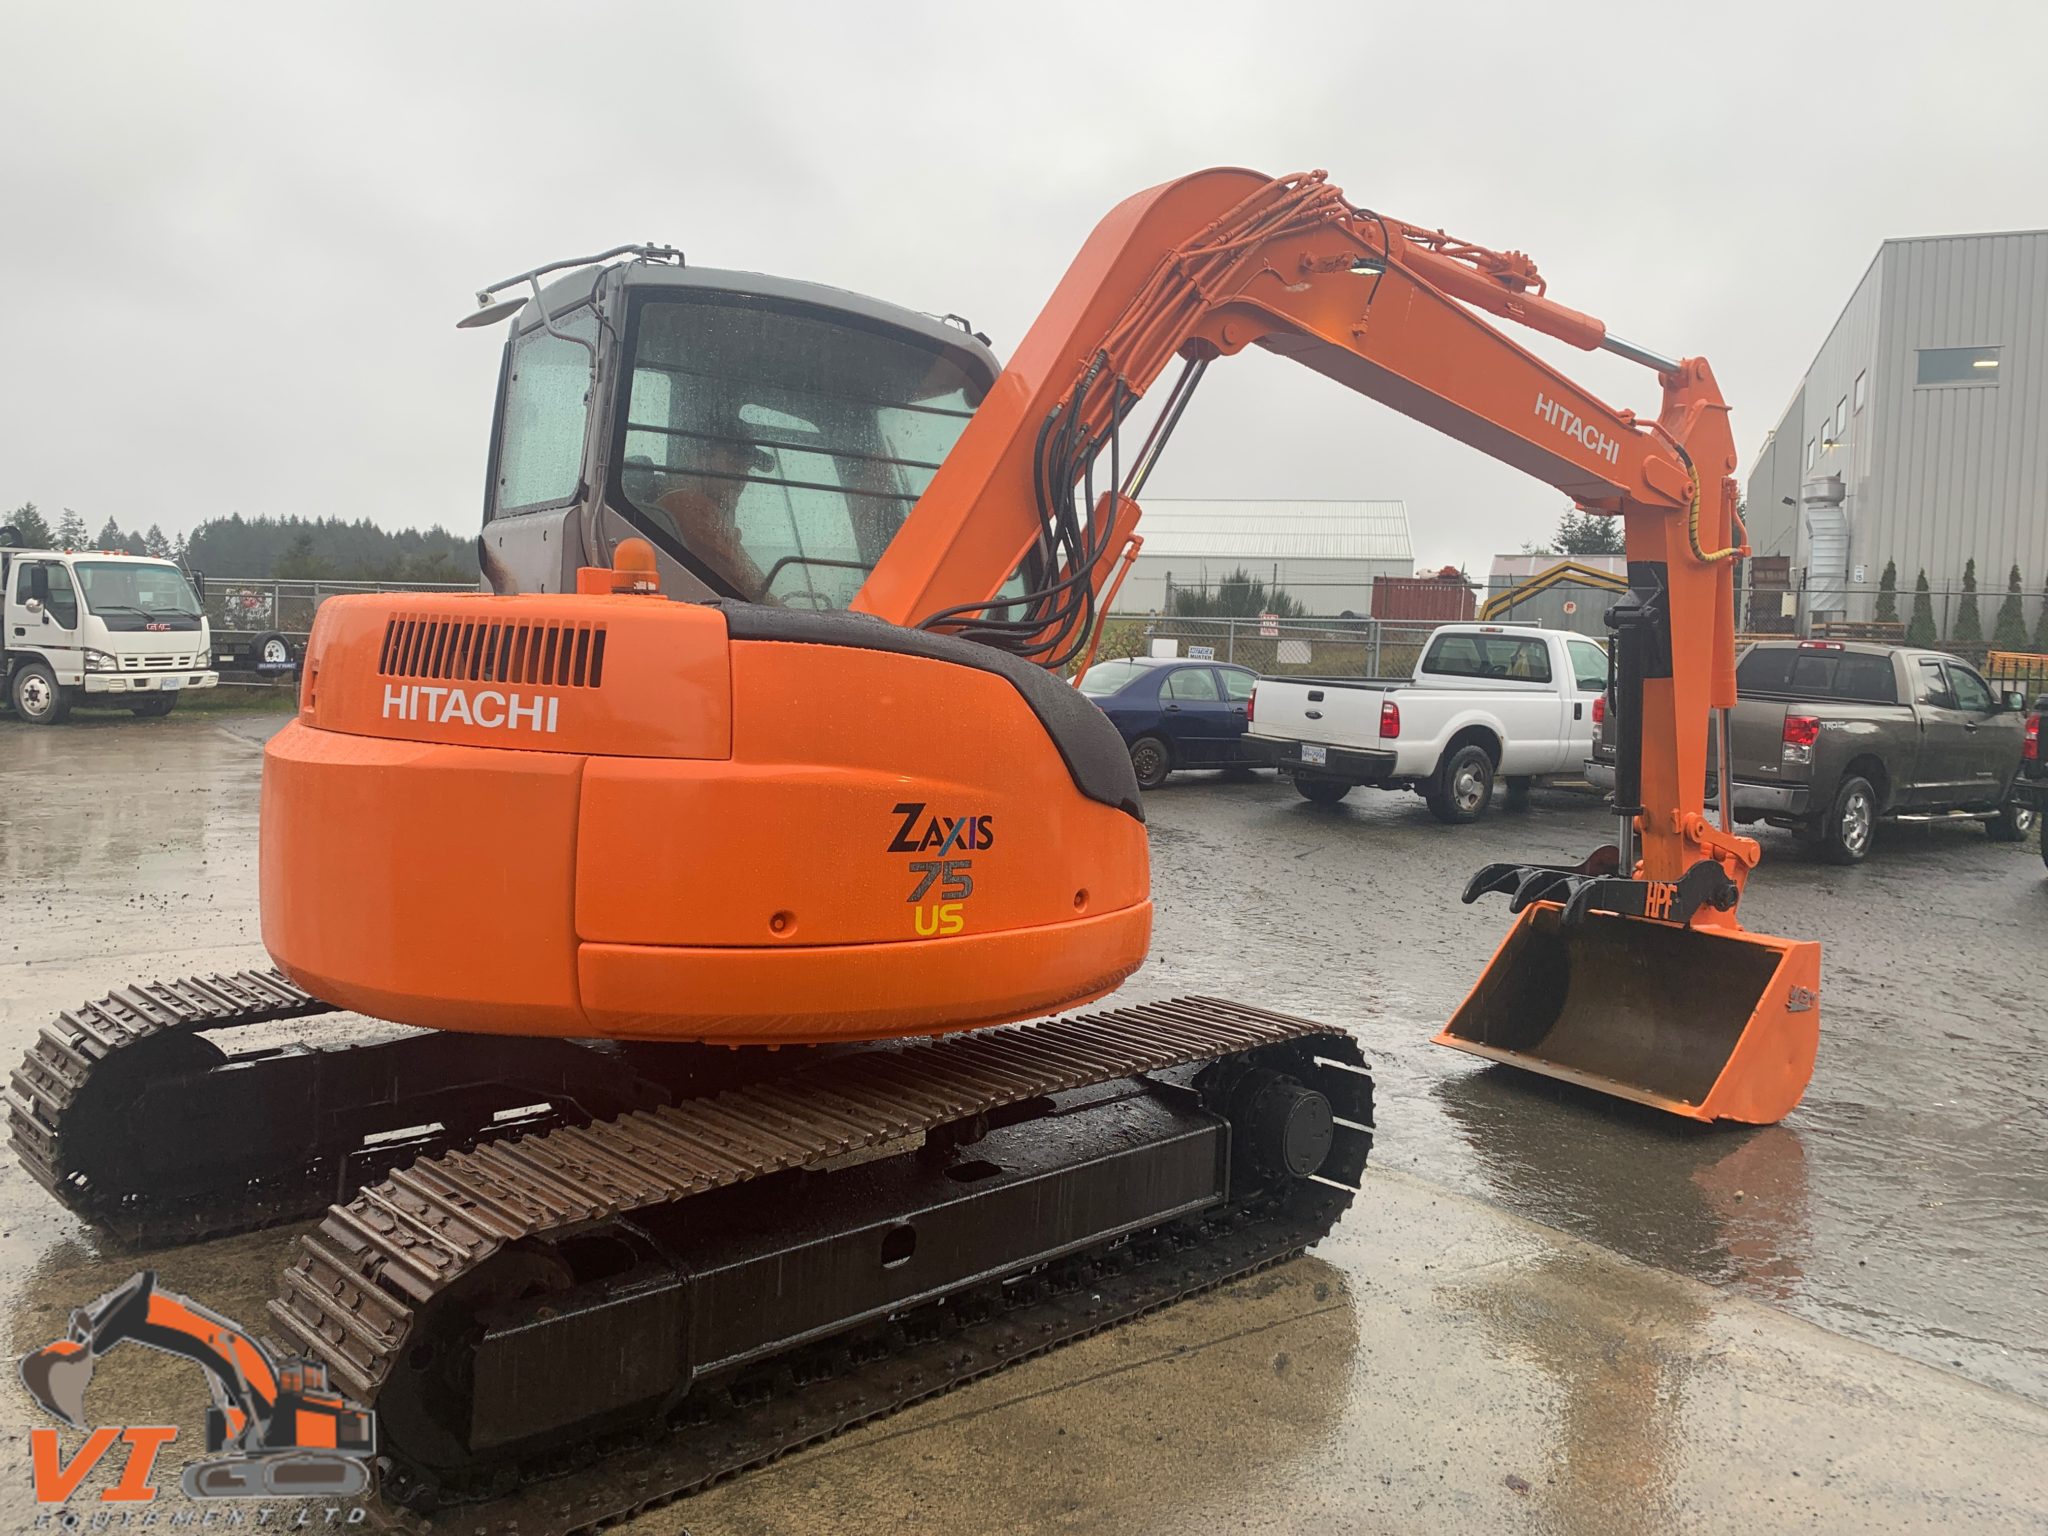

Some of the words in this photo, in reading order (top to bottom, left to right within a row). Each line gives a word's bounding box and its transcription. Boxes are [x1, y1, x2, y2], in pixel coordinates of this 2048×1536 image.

[1534, 392, 1619, 465] HITACHI
[382, 683, 559, 733] HITACHI
[886, 802, 995, 857] ZAXIS
[906, 859, 974, 902] 75
[1644, 881, 1678, 919] HPF
[915, 902, 964, 936] US
